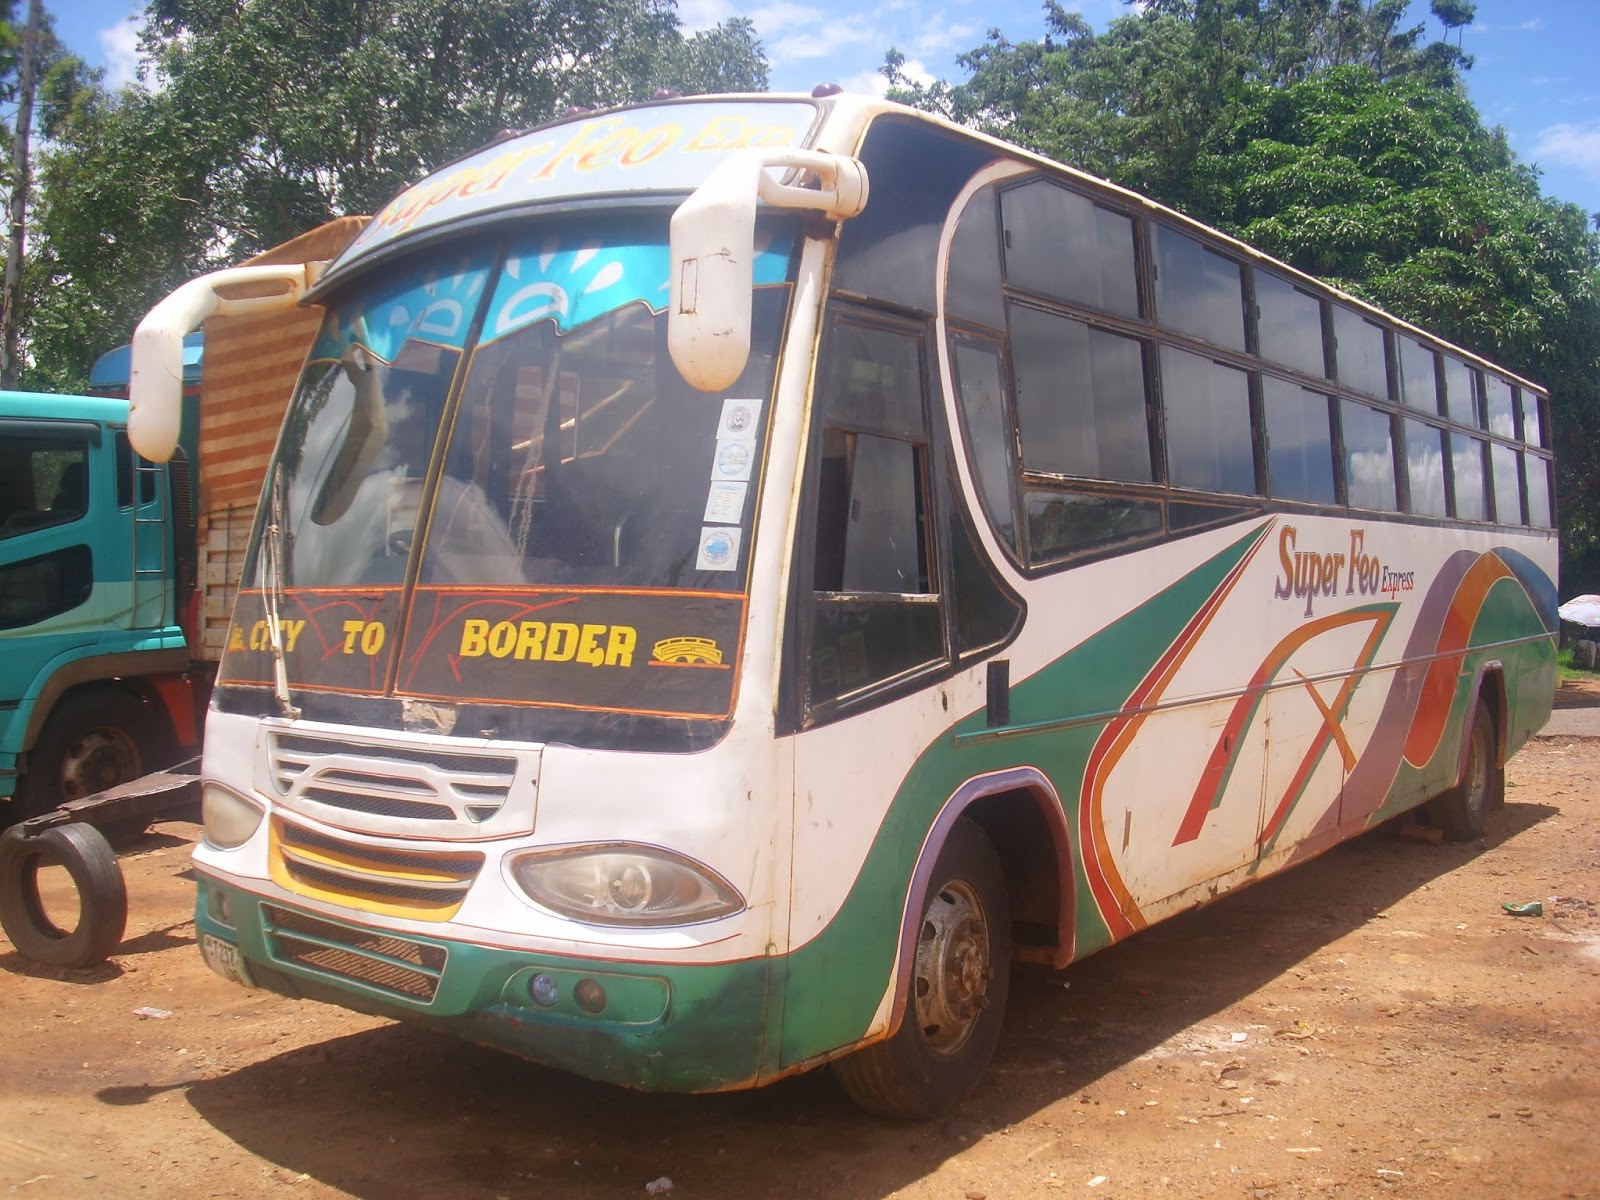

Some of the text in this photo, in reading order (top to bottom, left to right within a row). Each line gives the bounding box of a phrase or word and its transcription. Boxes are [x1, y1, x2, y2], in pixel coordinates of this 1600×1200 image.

[355, 144, 552, 246] Super
[528, 116, 683, 184] Feo
[1273, 524, 1415, 619] Super Feo Express
[342, 620, 386, 656] TO
[458, 618, 638, 668] BORDER
